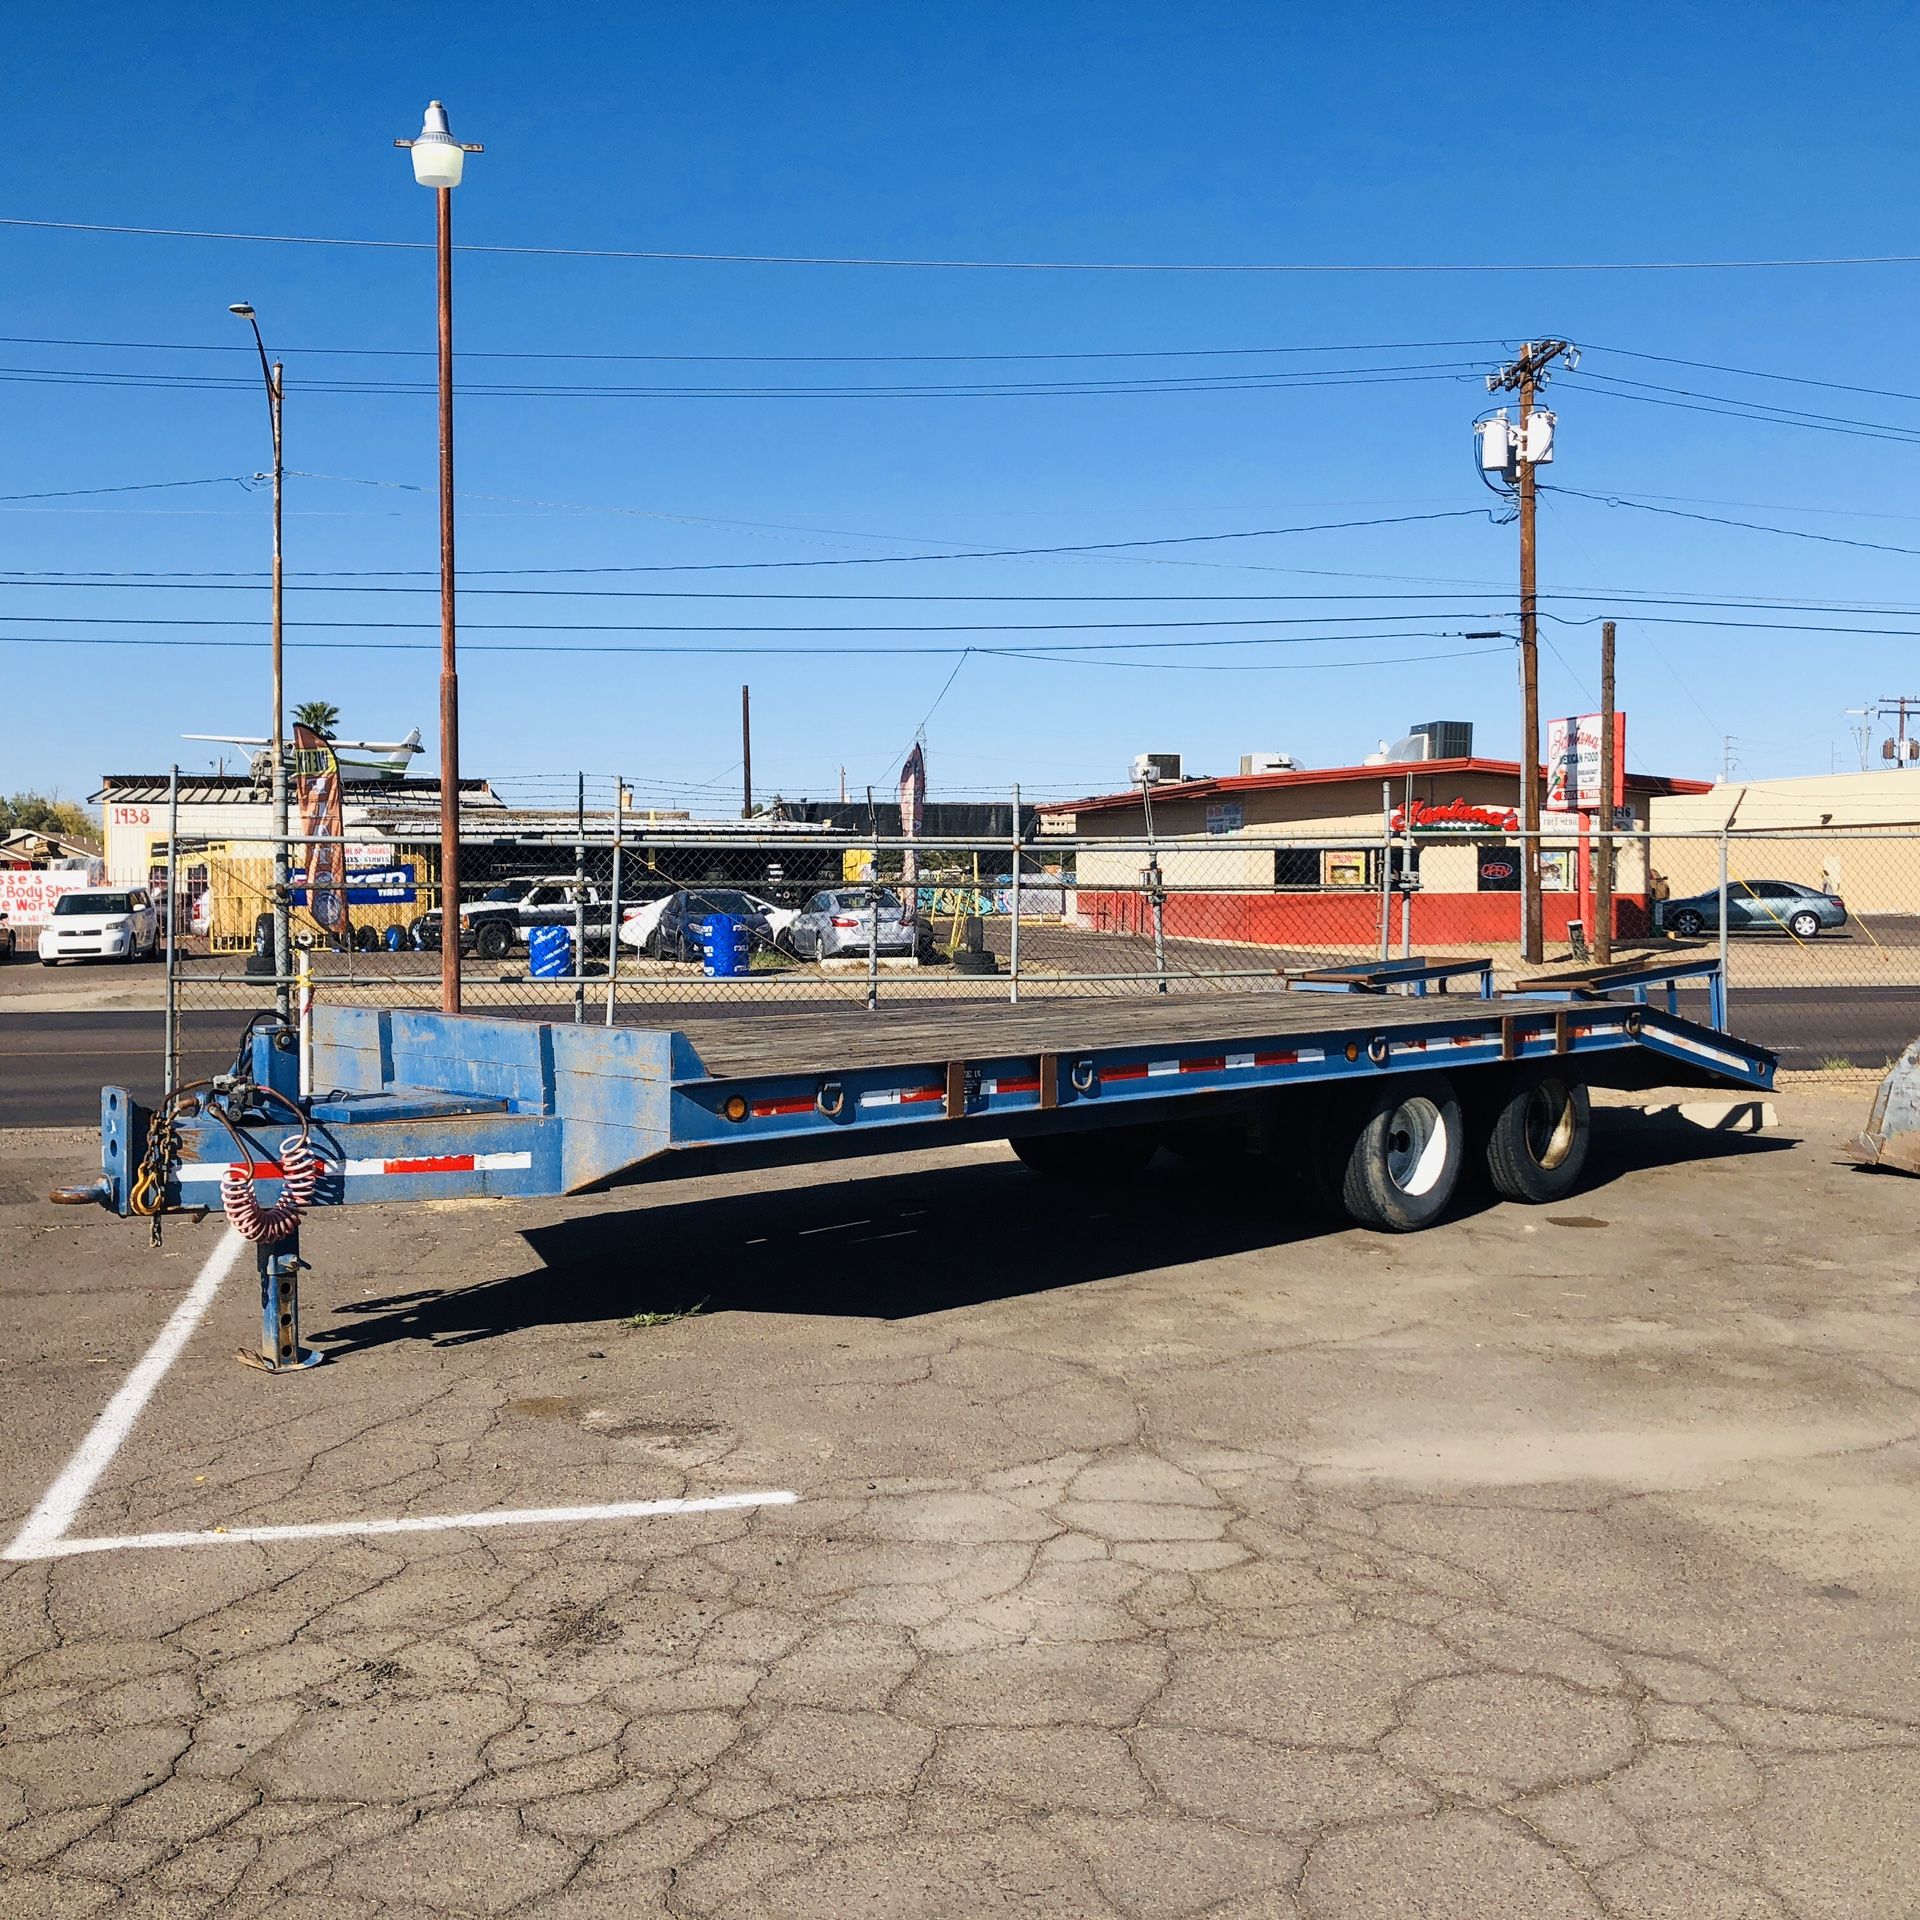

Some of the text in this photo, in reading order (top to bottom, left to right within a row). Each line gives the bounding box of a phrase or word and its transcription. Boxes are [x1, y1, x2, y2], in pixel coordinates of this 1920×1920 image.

[1560, 752, 1599, 765] MEXICAN FOOD
[1562, 790, 1583, 800] DRIVE
[114, 808, 150, 824] 1938
[1481, 863, 1510, 877] OPEN
[7, 886, 43, 903] Body
[377, 888, 405, 897] TIRES
